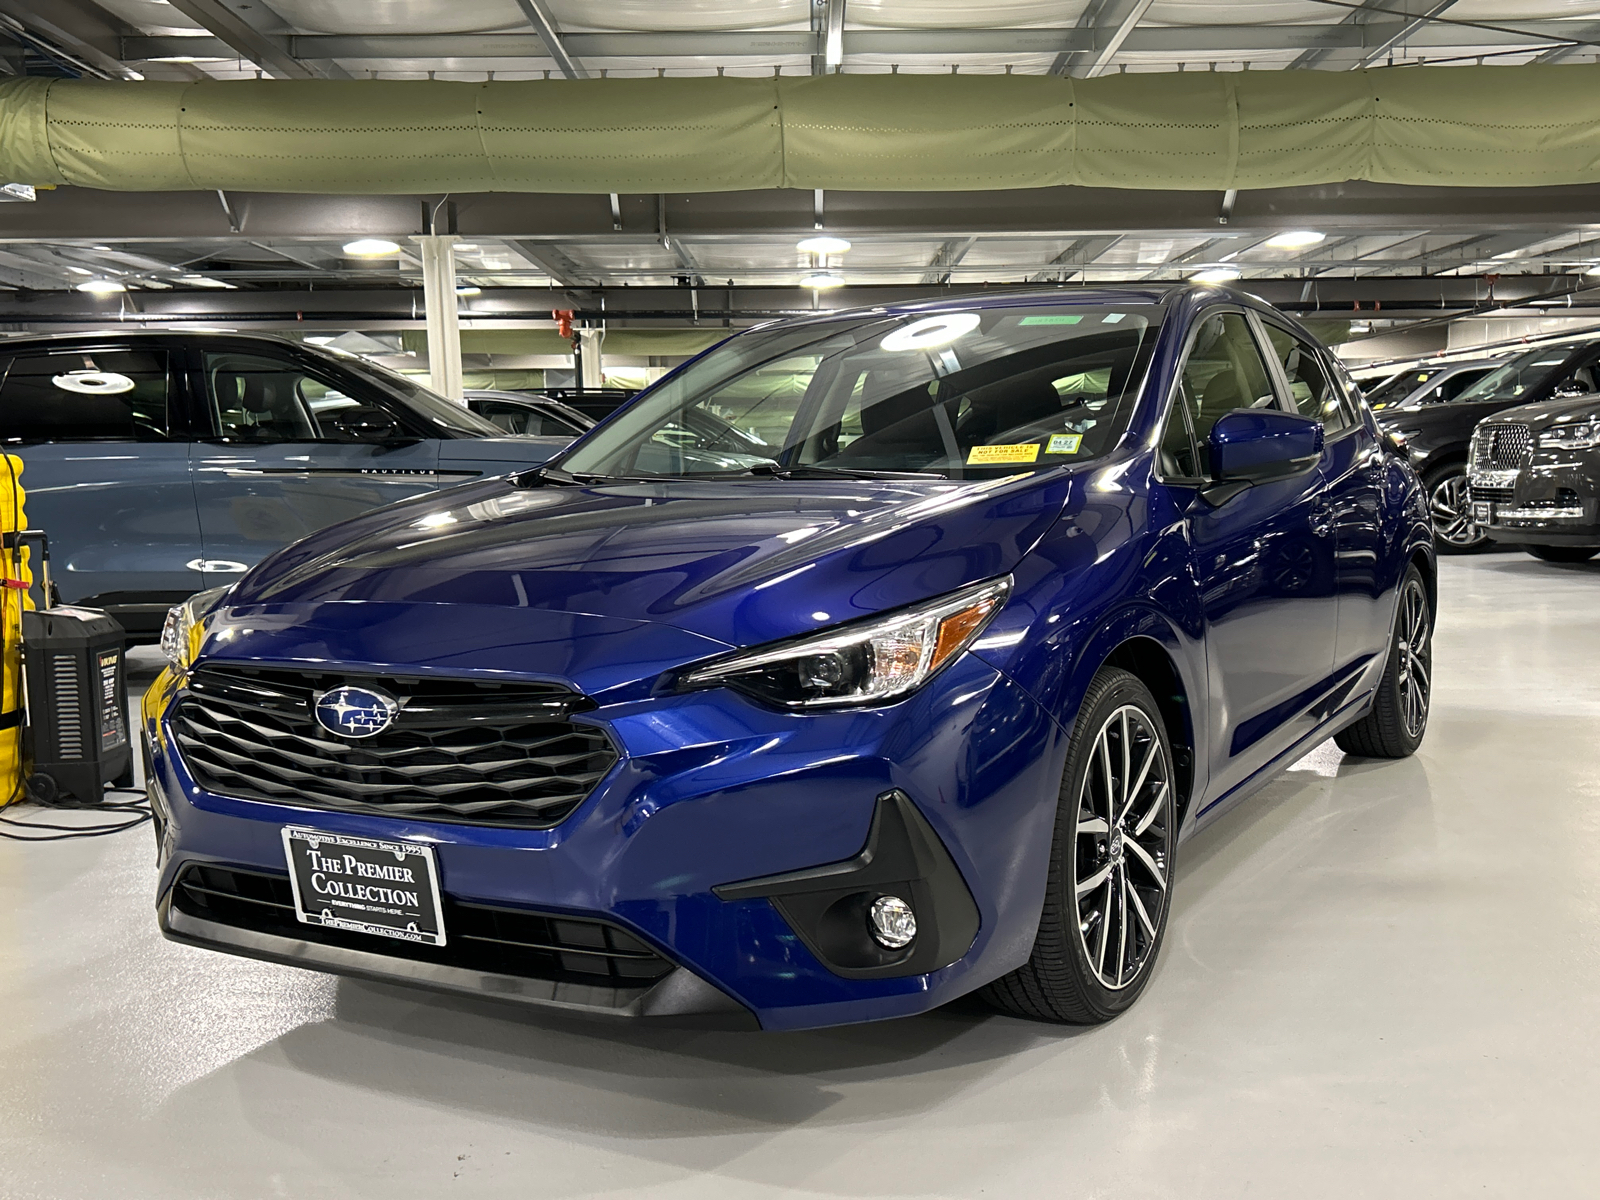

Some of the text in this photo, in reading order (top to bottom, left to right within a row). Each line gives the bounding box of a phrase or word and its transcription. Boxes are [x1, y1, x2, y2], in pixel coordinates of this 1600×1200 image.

[401, 844, 423, 855] 1995
[331, 899, 366, 911] EVERYTHING
[366, 905, 387, 914] STARTS
